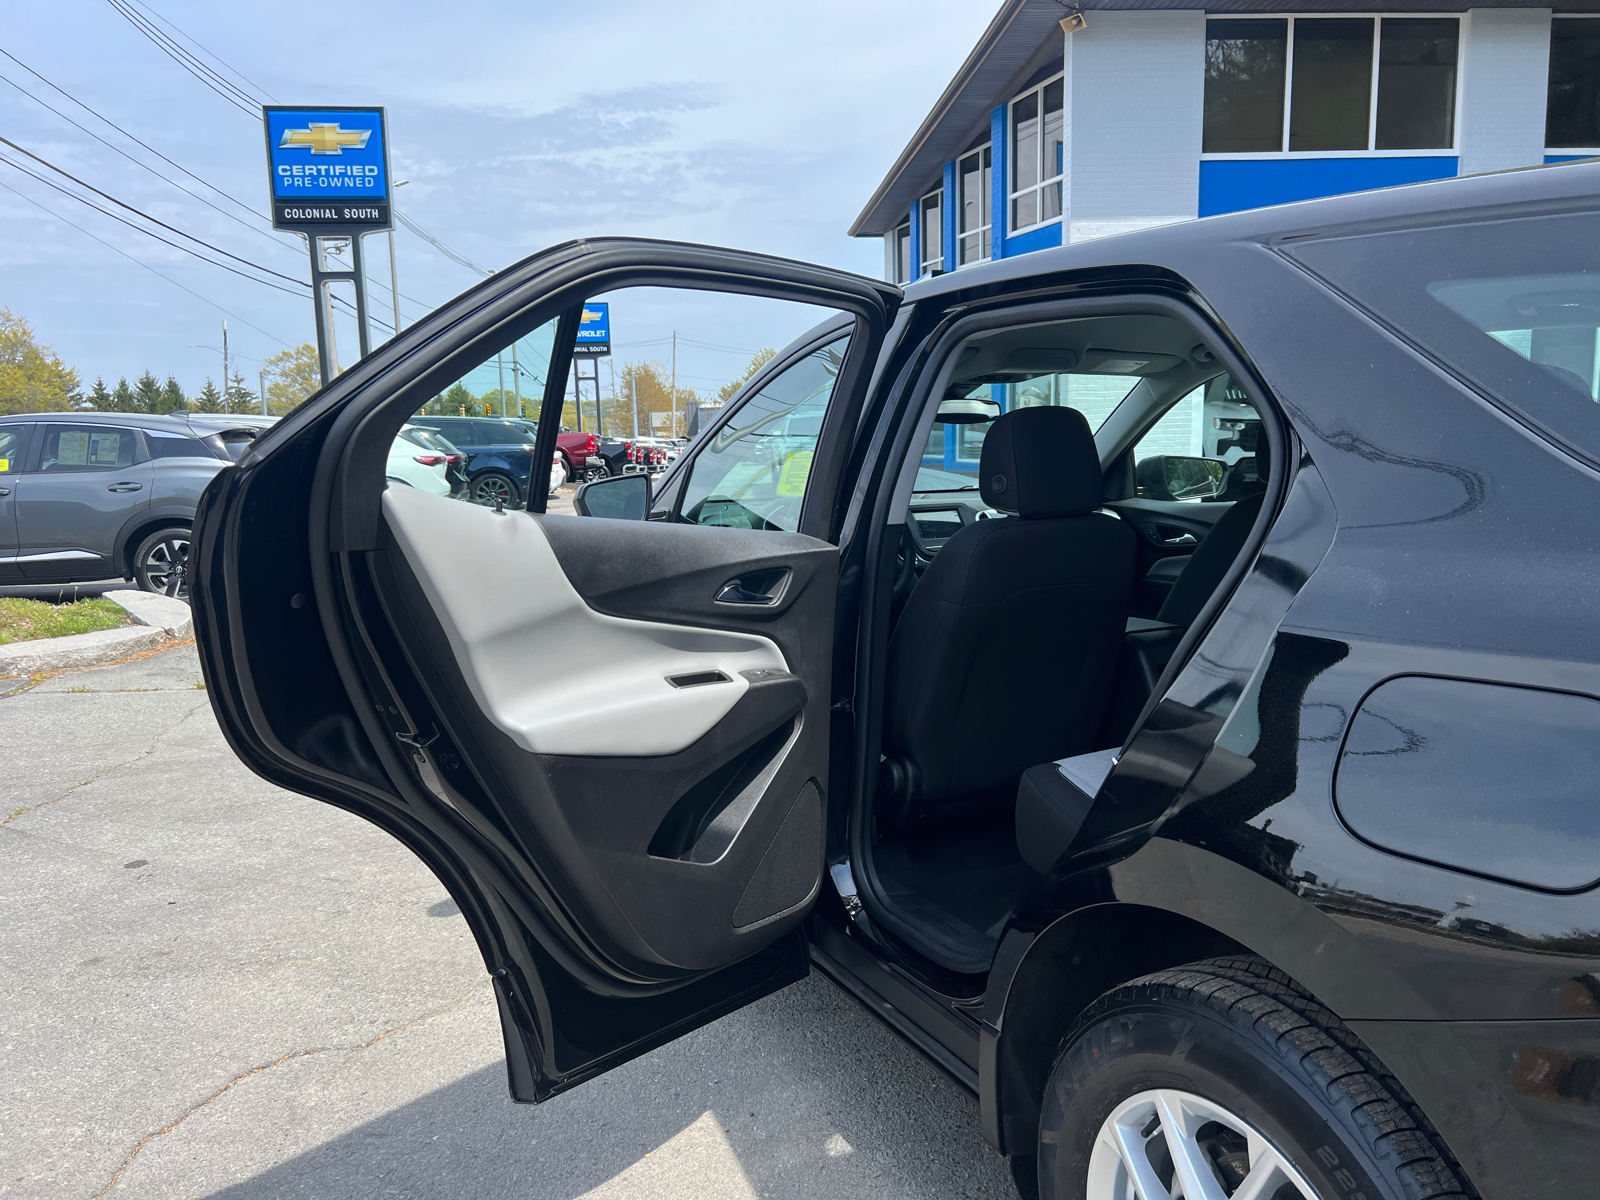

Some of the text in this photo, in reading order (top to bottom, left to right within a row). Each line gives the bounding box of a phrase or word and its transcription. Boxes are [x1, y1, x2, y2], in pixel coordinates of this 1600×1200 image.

[278, 165, 378, 176] CERTIFIED
[284, 177, 374, 187] PRE-OWNED
[284, 208, 379, 219] COLONIAL SOUTH
